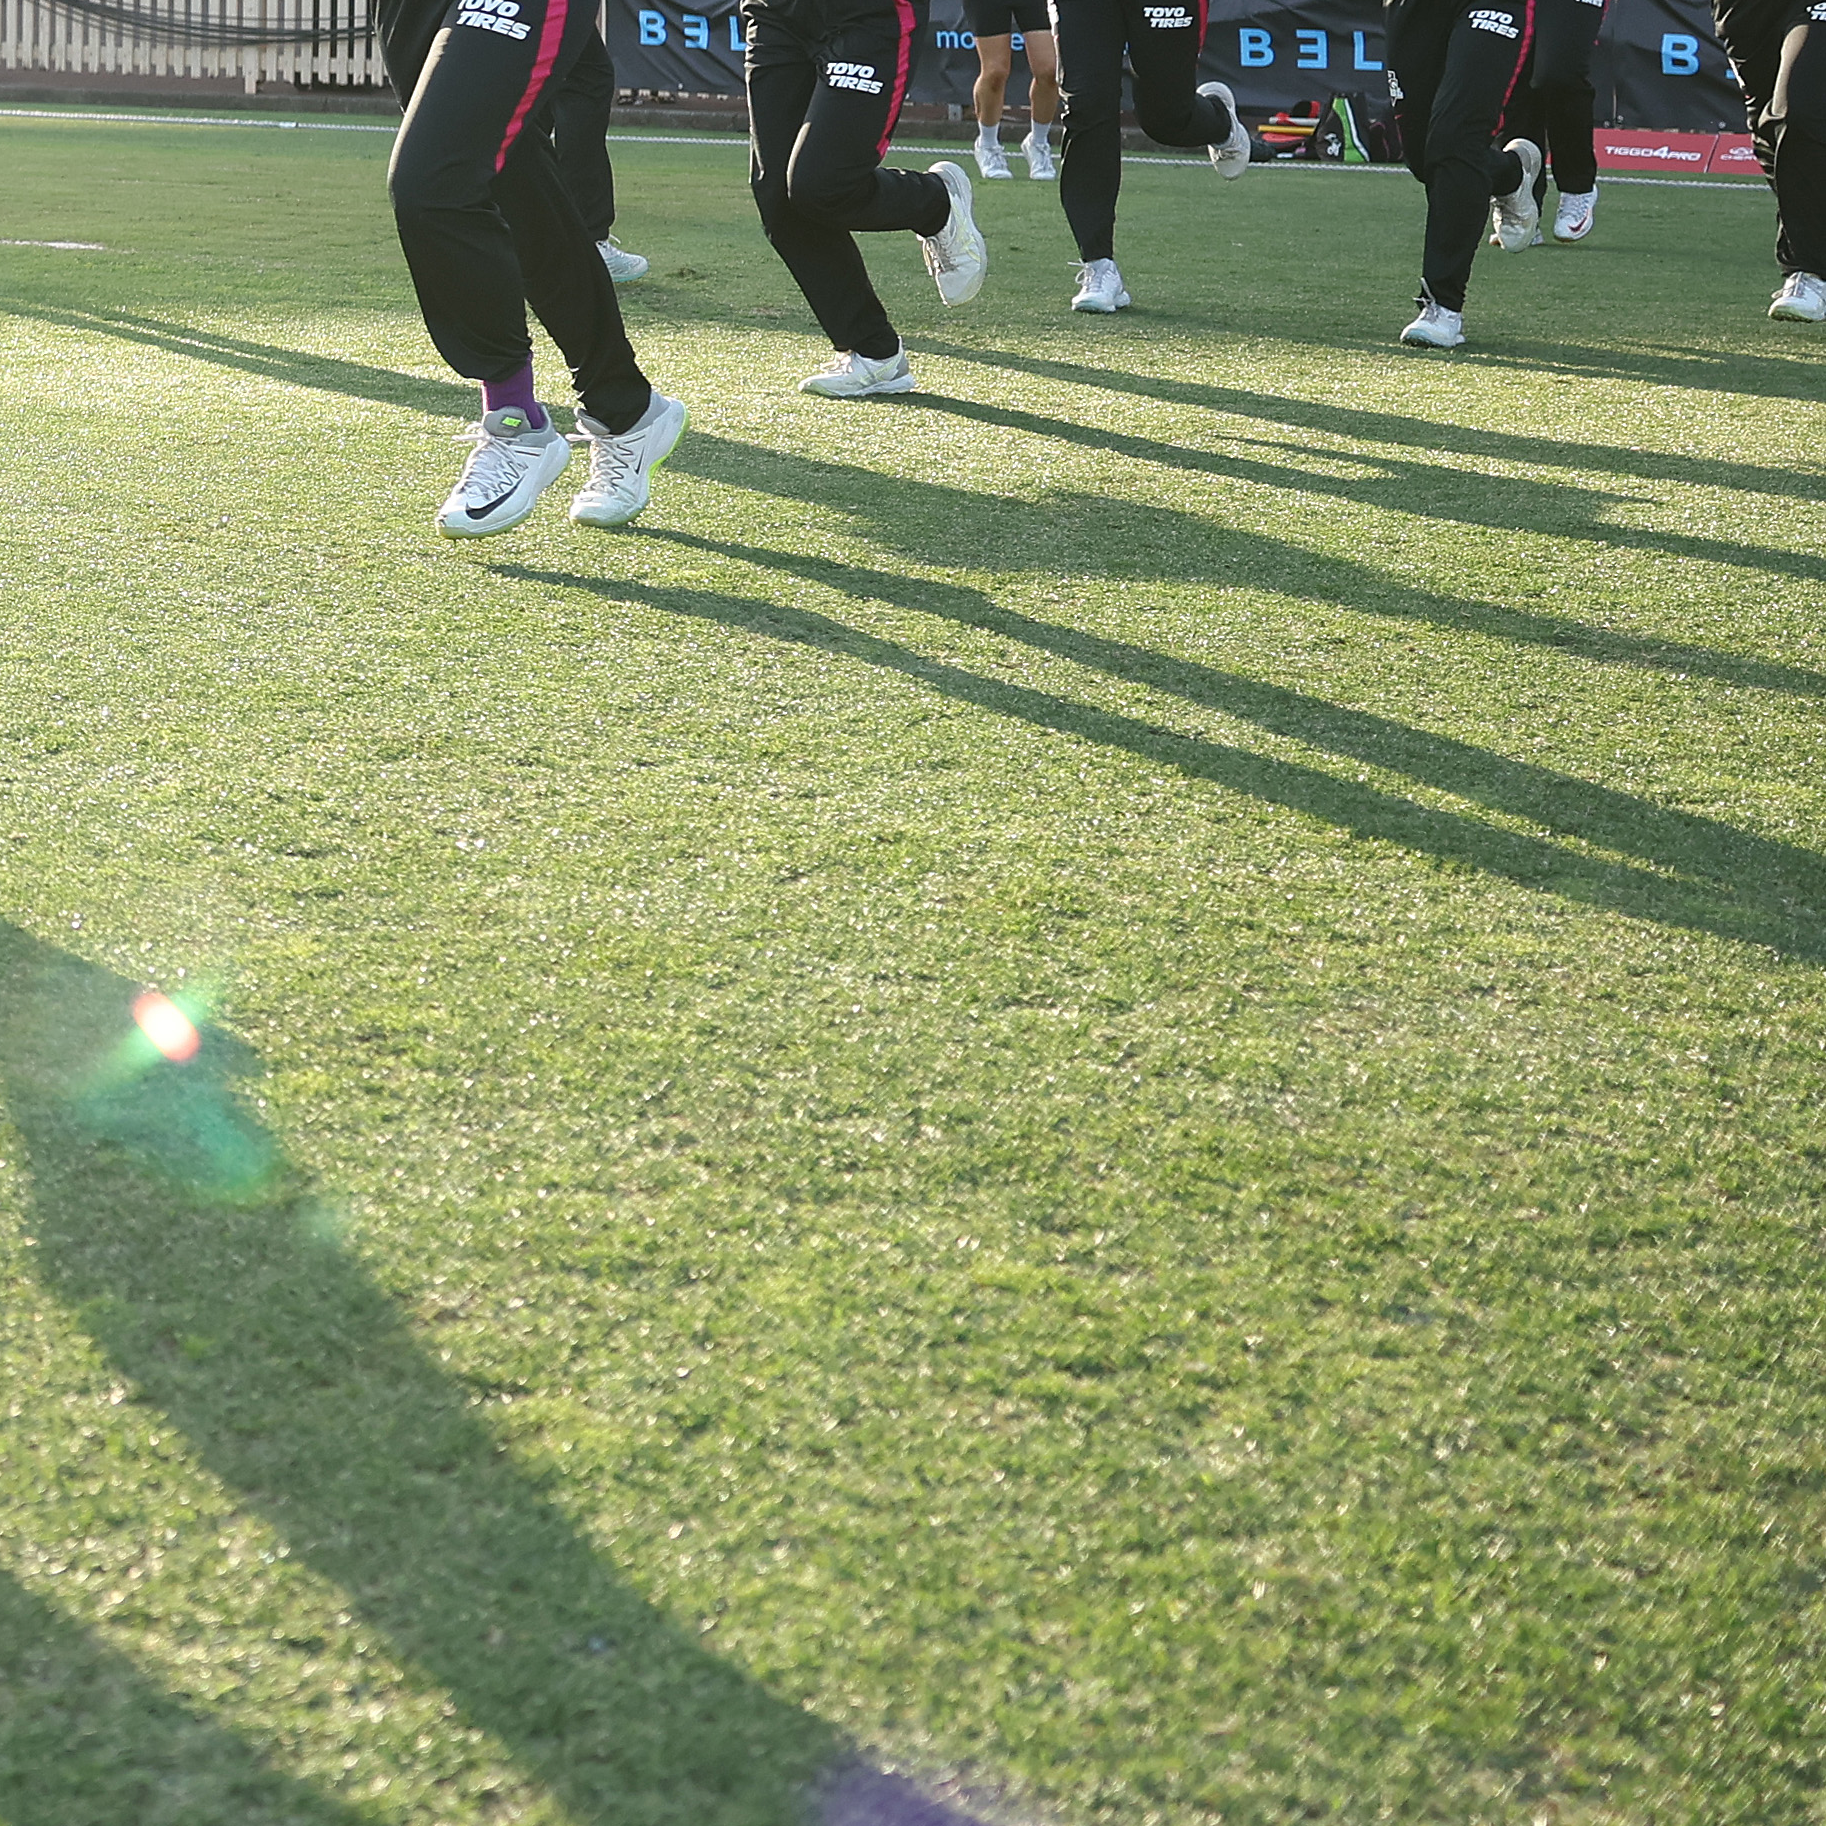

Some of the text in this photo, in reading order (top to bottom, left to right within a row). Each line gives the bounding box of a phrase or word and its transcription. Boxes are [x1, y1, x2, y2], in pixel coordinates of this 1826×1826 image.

[1143, 6, 1185, 18] TOYO
[456, 10, 531, 40] TIRES
[1149, 16, 1193, 28] TIRES
[1470, 18, 1520, 40] TIRES
[826, 62, 876, 79] TOYO
[828, 76, 884, 95] TIRES
